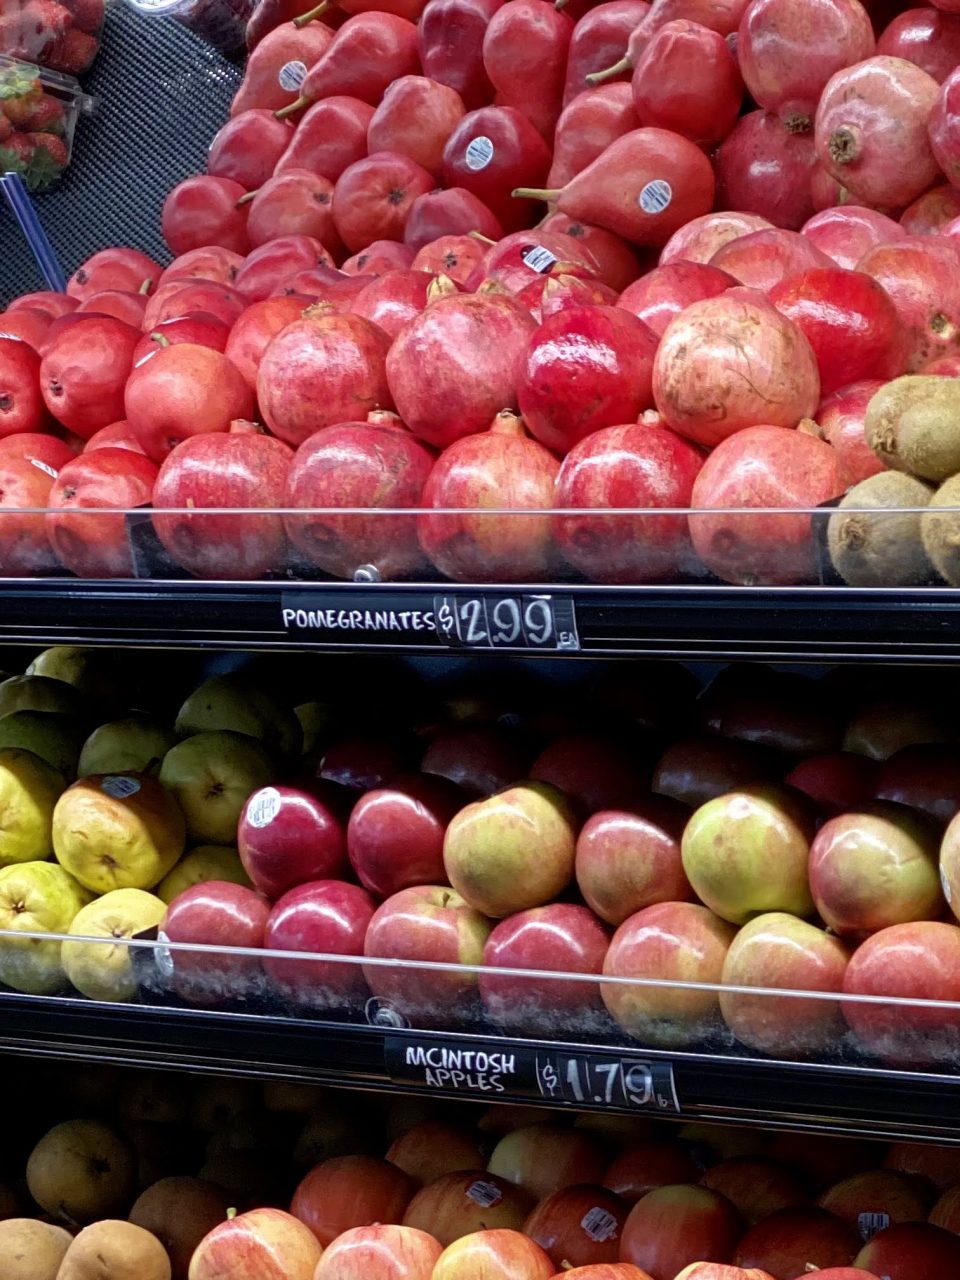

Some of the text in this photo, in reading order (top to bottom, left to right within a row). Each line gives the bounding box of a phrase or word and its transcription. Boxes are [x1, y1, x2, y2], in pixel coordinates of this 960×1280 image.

[282, 608, 436, 631] POMEGRANATES
[560, 631, 576, 644] EA
[406, 1046, 515, 1073] MCINTOSH
[425, 1067, 505, 1092] APPLES
